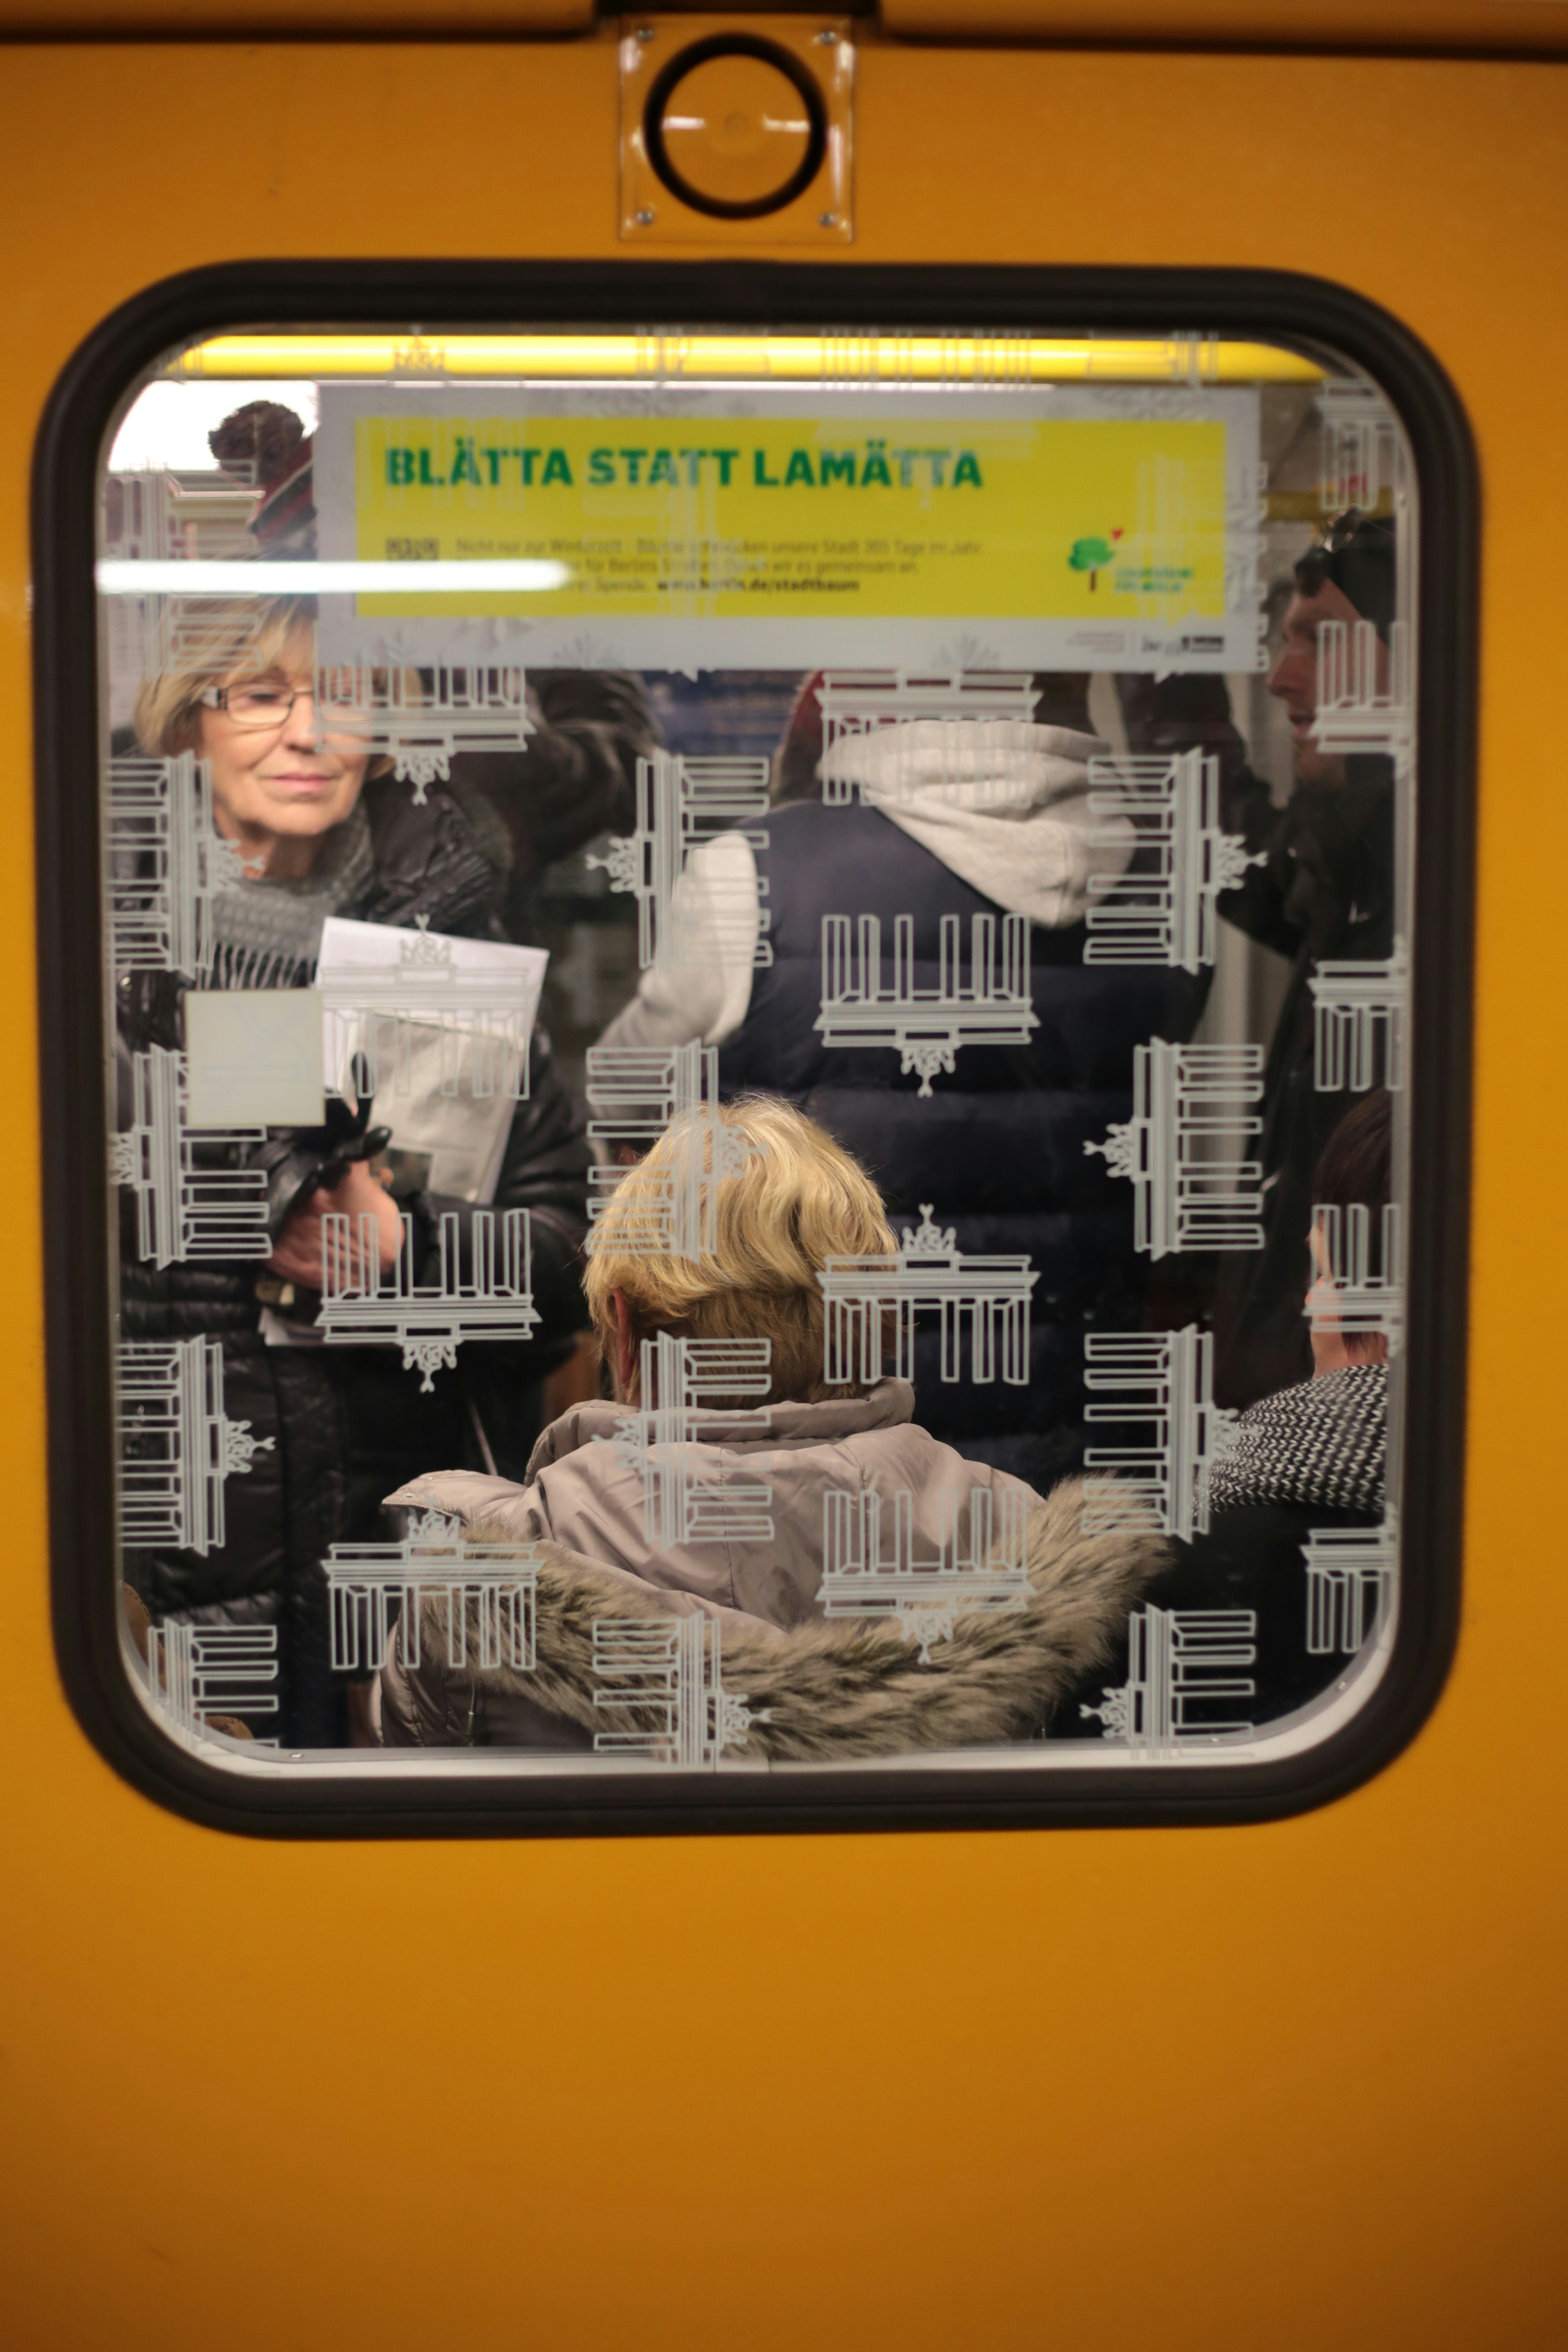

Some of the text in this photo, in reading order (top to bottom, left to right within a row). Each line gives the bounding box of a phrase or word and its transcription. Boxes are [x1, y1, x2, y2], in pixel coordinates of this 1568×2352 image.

[386, 436, 982, 486] BLÄTTA STATT LAMÄTTA
[822, 540, 860, 553] Stadt
[895, 540, 926, 557] Tage
